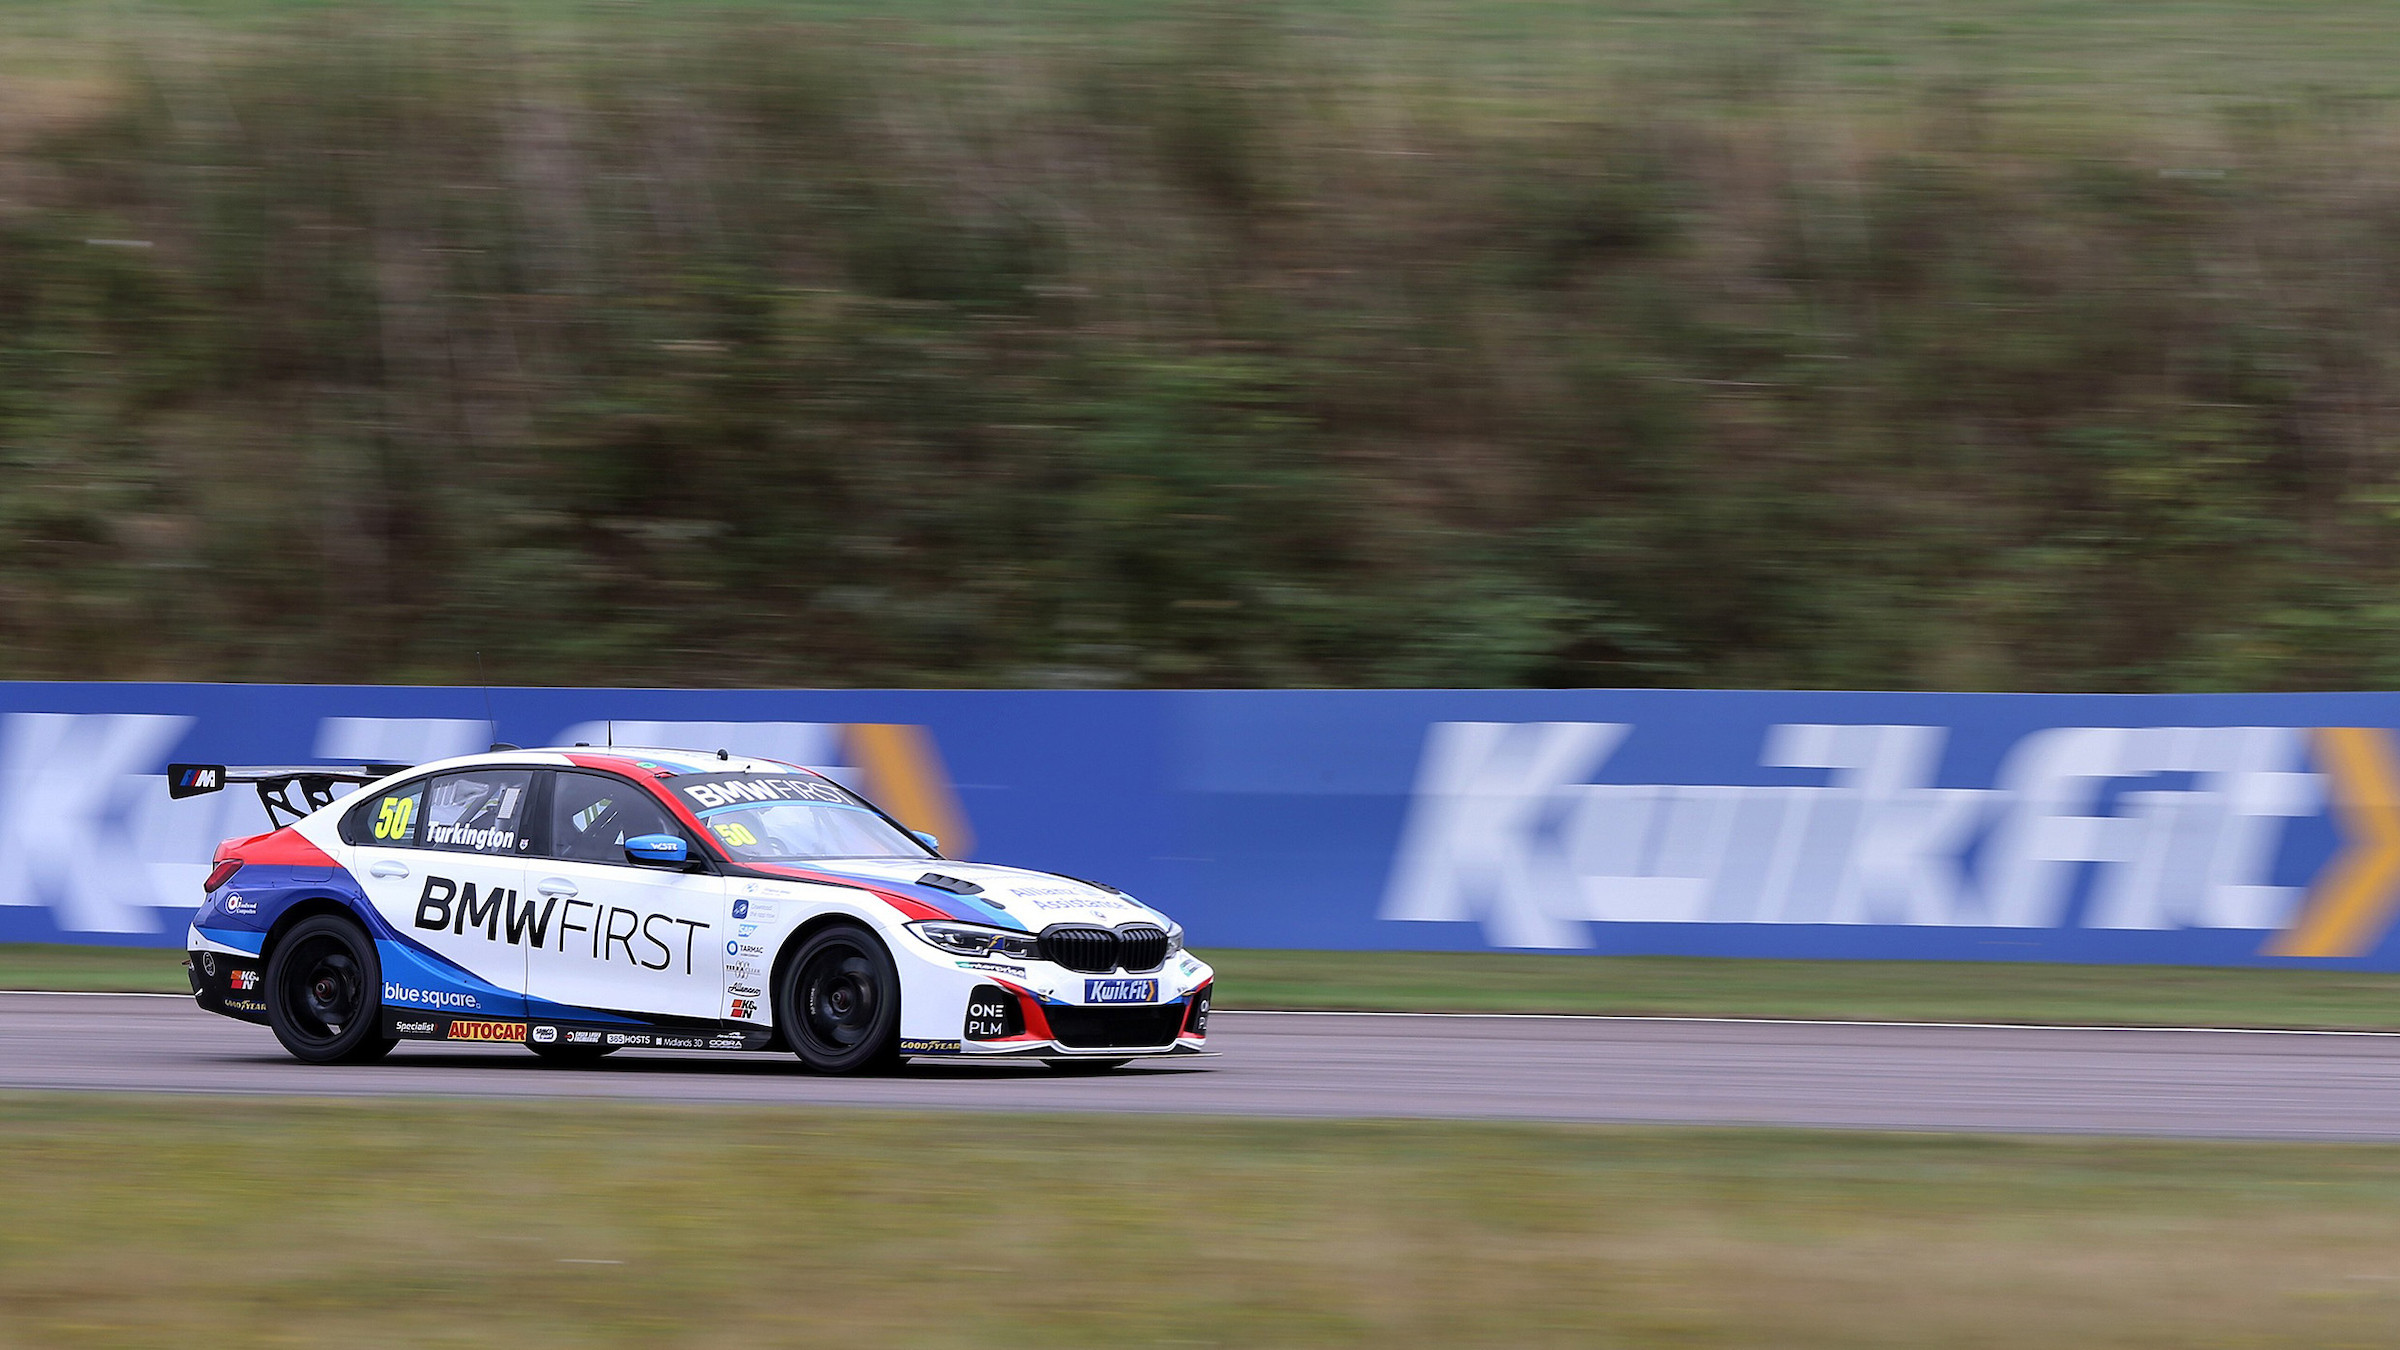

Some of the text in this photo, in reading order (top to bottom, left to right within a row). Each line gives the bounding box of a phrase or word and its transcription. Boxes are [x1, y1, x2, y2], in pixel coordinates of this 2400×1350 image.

[683, 779, 855, 808] BMWFIRST
[374, 797, 413, 840] 50
[426, 820, 515, 850] Turkington
[714, 822, 758, 847] 50
[1009, 887, 1079, 898] Allianz
[1033, 898, 1129, 911] Assistance
[414, 875, 711, 975] BMWFIRST
[740, 944, 764, 955] TARMAC
[384, 982, 420, 1001] blue
[970, 1003, 1005, 1018] ONE
[396, 1021, 435, 1033] Specialist
[448, 1021, 527, 1041] AUTOCAR
[969, 1020, 1003, 1035] PLM
[664, 1038, 692, 1048] Midlands
[693, 1038, 704, 1048] 3D
[900, 1040, 961, 1052] GOODYEAR
